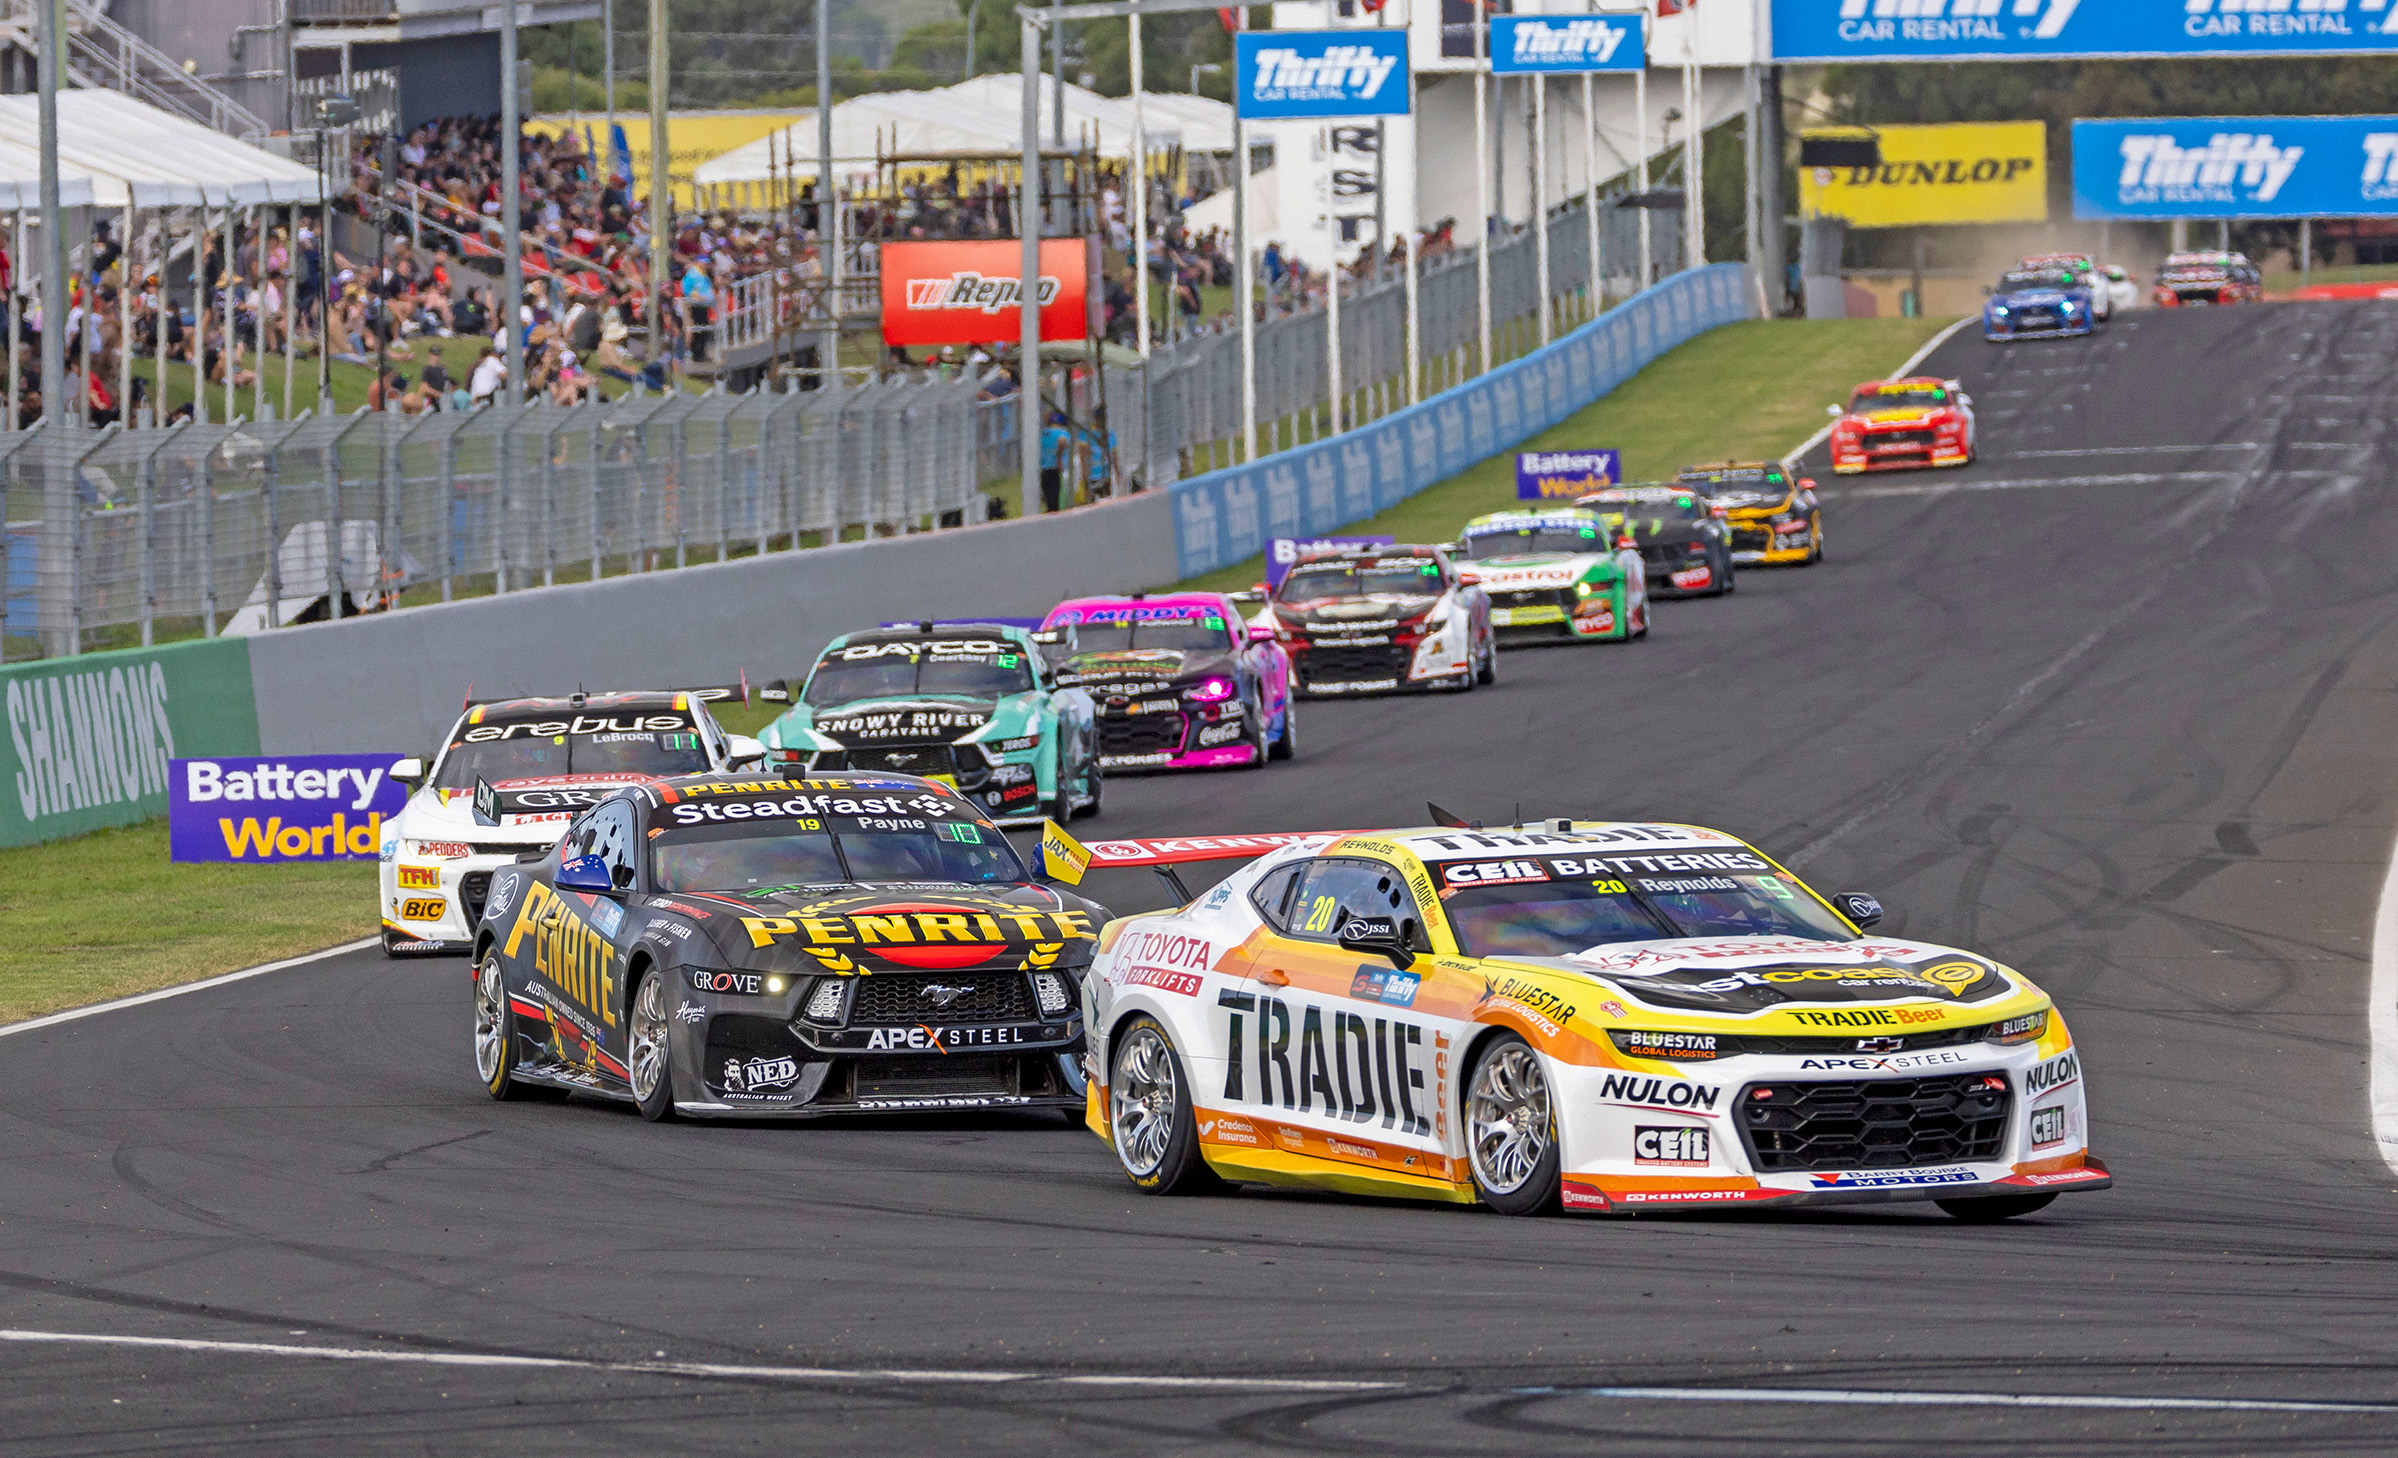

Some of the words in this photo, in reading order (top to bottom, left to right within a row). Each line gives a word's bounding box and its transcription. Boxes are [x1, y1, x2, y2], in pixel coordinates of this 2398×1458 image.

[1838, 19, 1895, 41] CAR
[1902, 17, 2006, 40] RENTAL
[2184, 15, 2242, 37] CAR
[2250, 13, 2353, 35] RENTAL
[1513, 20, 1627, 63] Thrifty
[1254, 45, 1399, 100] Thrifty
[1253, 86, 1287, 102] CAR
[1288, 86, 1347, 101] RENTAL
[1846, 157, 2034, 187] DUNLOP
[2119, 133, 2305, 202] Thrifty
[1522, 452, 1611, 476] Battery
[842, 640, 1000, 661] DAYCO
[997, 653, 1019, 669] 12
[464, 716, 685, 742] erebus
[815, 713, 903, 733] SNOWY
[912, 712, 985, 727] RIVER
[859, 726, 941, 739] CARAVANS
[7, 661, 175, 822] SHANNONS
[592, 732, 655, 746] LeBrocq
[187, 761, 384, 811] Battery
[683, 779, 852, 798] PENRITE
[672, 795, 906, 825] Steadfast
[218, 812, 381, 858] World
[797, 818, 820, 832] 19
[858, 816, 927, 832] Payne
[948, 822, 982, 844] 10
[429, 842, 469, 858] PEDDERS
[1043, 836, 1071, 863] JAX
[1339, 839, 1396, 855] REYNOLDS
[1551, 852, 1770, 876] BATTERIES
[399, 868, 434, 885] TFH
[1592, 879, 1628, 895] 20
[1637, 876, 1736, 894] Reynolds
[1411, 873, 1436, 912] TRADIE
[1304, 895, 1336, 933] 20
[1422, 905, 1440, 931] Beer
[667, 922, 693, 940] FISHER
[739, 910, 1099, 950] PENRITE
[1367, 924, 1390, 935] JSSI
[503, 880, 617, 1030] PENRITE
[1137, 932, 1211, 971] TOYOTA
[694, 970, 760, 994] GROVE
[1130, 968, 1197, 993] FORKLIFTS
[1837, 979, 1872, 988] car
[524, 980, 559, 1010] AUSTRALIAN
[573, 1010, 586, 1030] SINCE
[1498, 978, 1577, 1026] BLUESTAR
[1511, 1001, 1561, 1038] LOGISTICS
[1786, 1010, 1898, 1027] TRADIE
[1894, 1007, 1948, 1025] Beer
[2002, 1013, 2044, 1036] BLUESTAR
[866, 1026, 946, 1053] APEX
[950, 1028, 1023, 1045] STEEL
[1630, 1031, 1716, 1050] BLUESTAR
[1217, 987, 1431, 1138] TRADIE
[1630, 1046, 1667, 1056] GLOBAL
[1669, 1047, 1716, 1059] LOGISTICS
[1799, 1057, 1896, 1073] APEX
[1897, 1052, 1969, 1068] STEEL
[746, 1060, 797, 1085] NED
[2026, 1054, 2078, 1096] NULON
[1600, 1074, 1721, 1112] NULON
[1217, 1118, 1254, 1134] Credence
[1217, 1130, 1258, 1145] Insurance
[1336, 1140, 1378, 1160] KENWORTH
[1846, 1170, 1890, 1180] BARRY
[1892, 1166, 1969, 1177] BOURKE
[1854, 1173, 1974, 1187] MOTORS
[1648, 1191, 1746, 1200] KENWORTH
